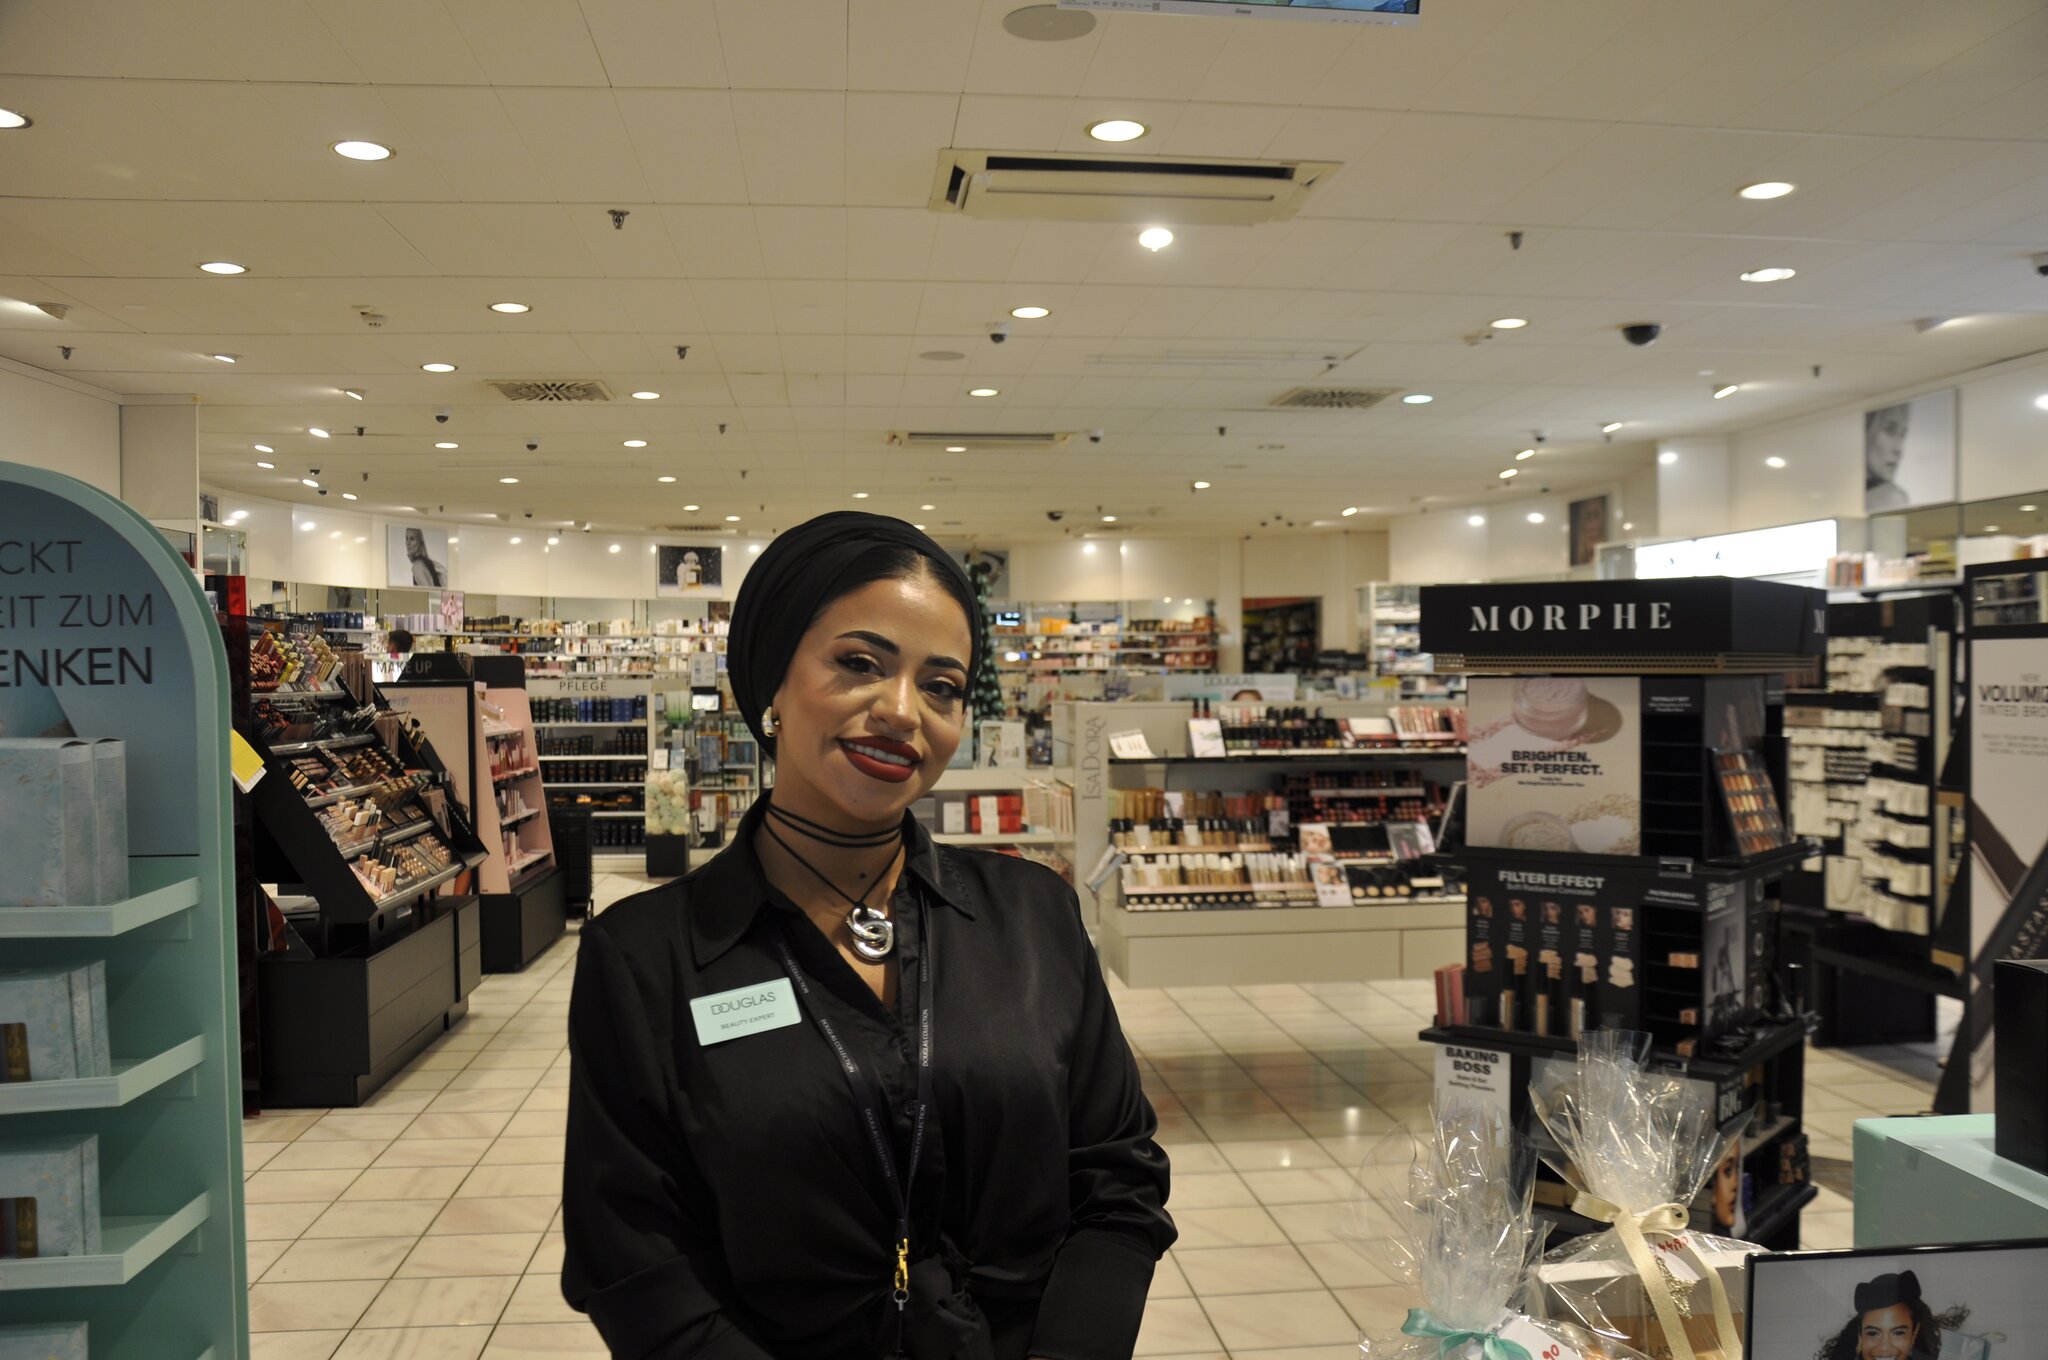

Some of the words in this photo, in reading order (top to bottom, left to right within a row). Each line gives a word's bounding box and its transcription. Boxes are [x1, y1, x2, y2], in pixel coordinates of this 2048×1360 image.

[0, 595, 45, 628] IT
[59, 593, 153, 628] ZUM
[1469, 602, 1672, 632] MORPHE
[376, 661, 412, 674] MAKE
[415, 660, 433, 673] UP
[559, 681, 607, 692] PFLEGE
[1204, 676, 1257, 687] DOUGLAS
[1511, 750, 1592, 763] BRIGHTEN.
[1501, 763, 1531, 774] SET.
[1533, 764, 1604, 776] PERFECT.
[1498, 870, 1547, 884] FILTER
[1549, 874, 1605, 889] EFFECT
[711, 991, 776, 1016] DOUGLAS
[720, 1019, 748, 1031] BEAUTY
[749, 1012, 775, 1024] EXPERT
[820, 1018, 840, 1044] DOUGLAS
[834, 1041, 855, 1073] COLLECTION
[921, 1038, 929, 1067] DOUGLAS
[1445, 1046, 1499, 1064] BAKING
[1453, 1060, 1491, 1075] BOSS
